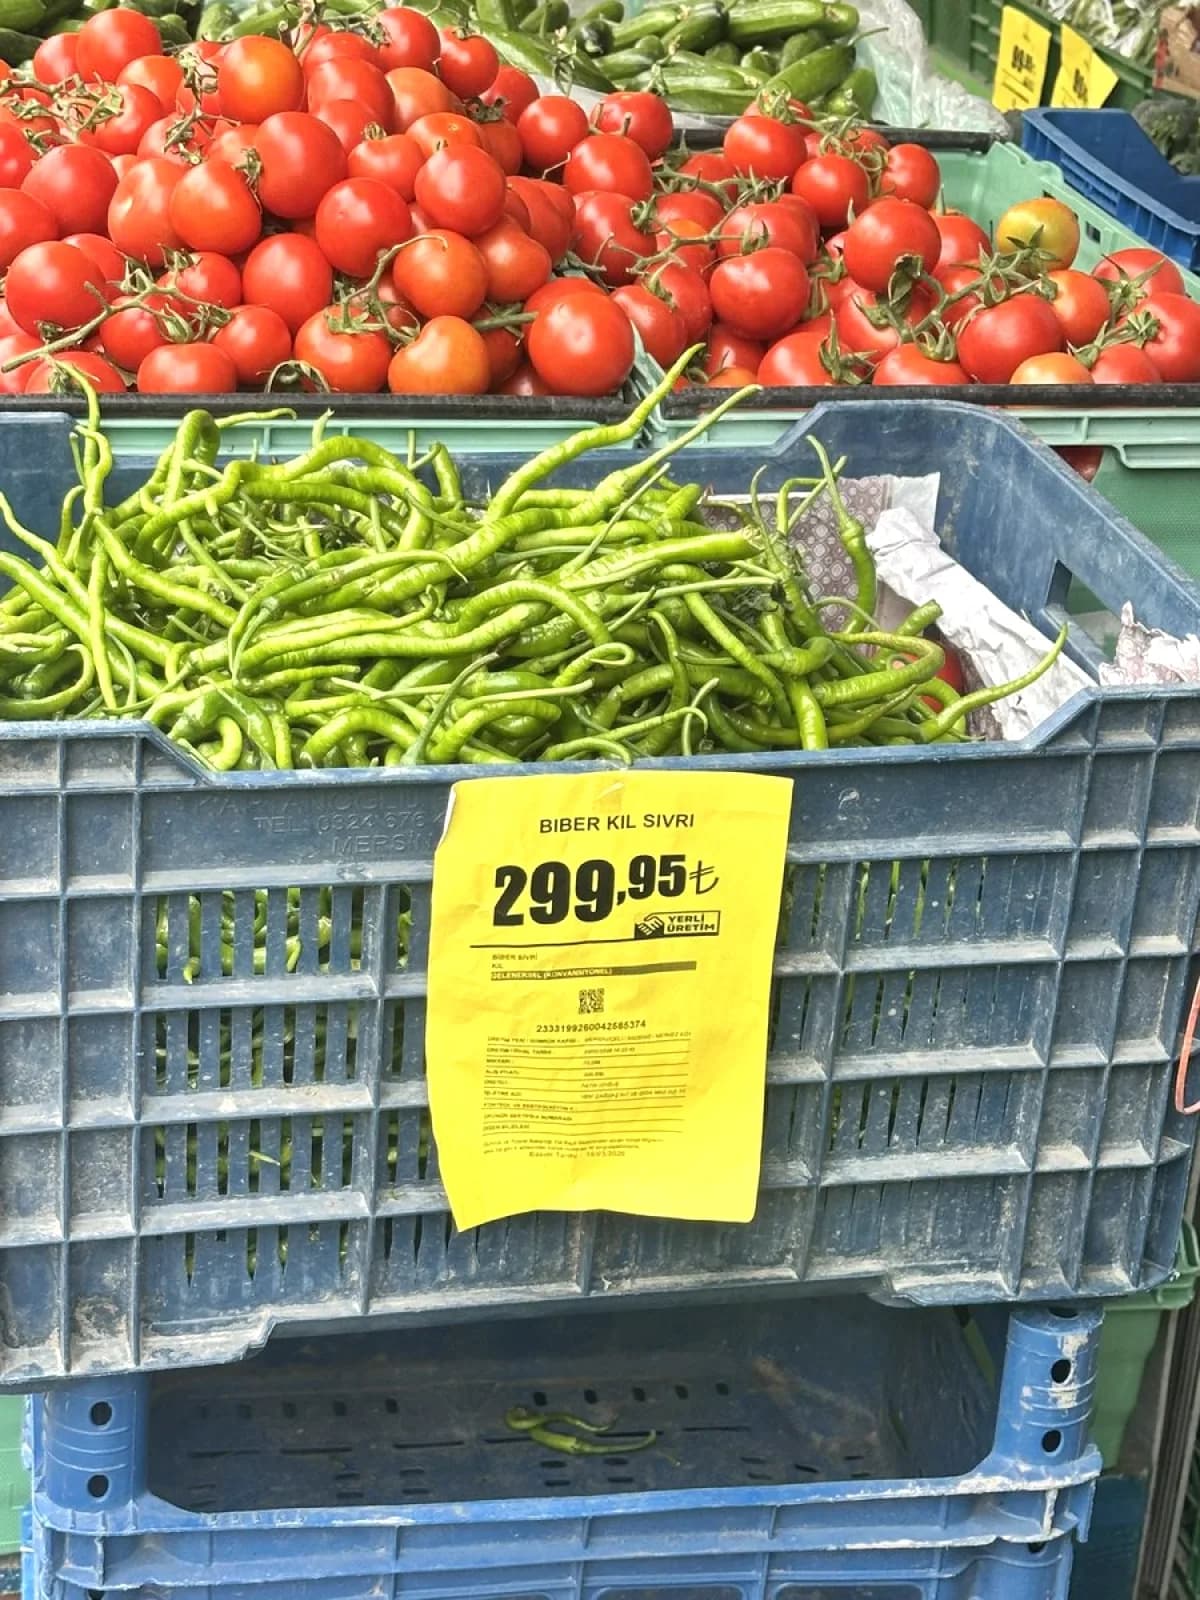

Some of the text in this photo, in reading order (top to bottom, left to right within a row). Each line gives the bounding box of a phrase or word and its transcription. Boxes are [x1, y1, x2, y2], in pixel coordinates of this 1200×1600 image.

[539, 813, 694, 833] BIBER KIL SIVRI
[668, 912, 704, 923] YERLİ
[667, 923, 715, 932] ÜRETİM
